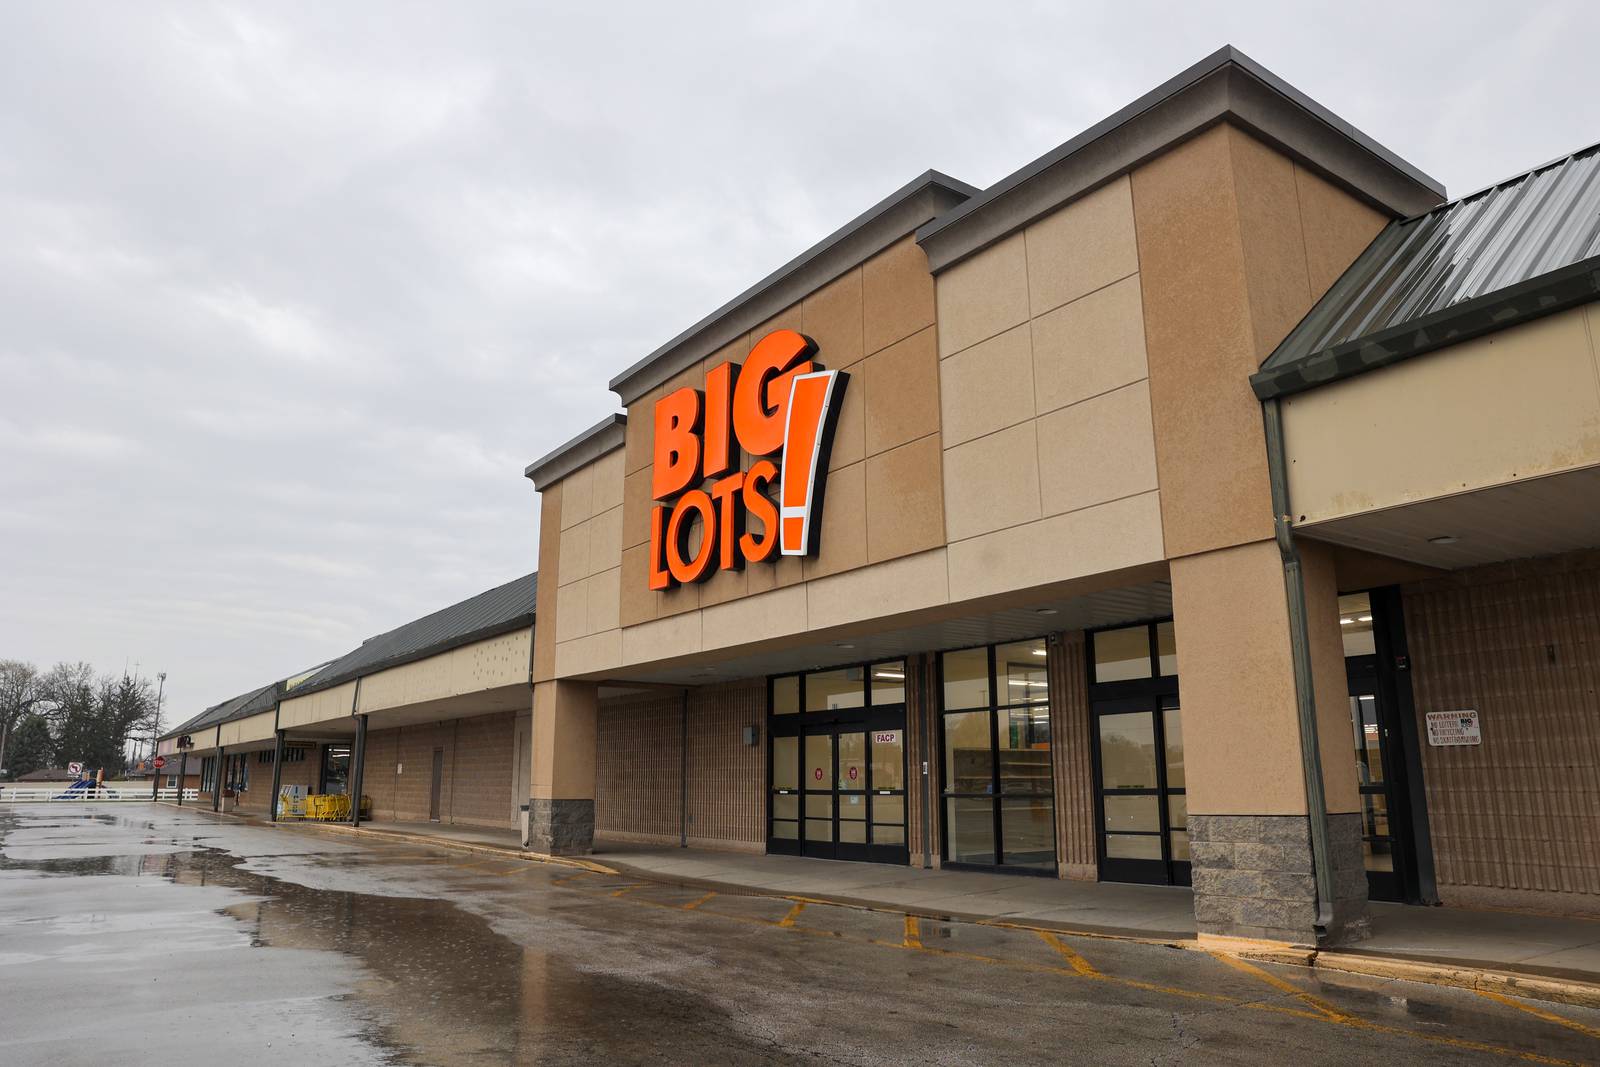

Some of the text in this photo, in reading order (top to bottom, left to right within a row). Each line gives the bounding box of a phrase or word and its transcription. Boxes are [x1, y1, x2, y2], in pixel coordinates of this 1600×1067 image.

[653, 329, 815, 501] BIG
[1427, 712, 1476, 720] WARNING
[876, 734, 895, 742] FACP
